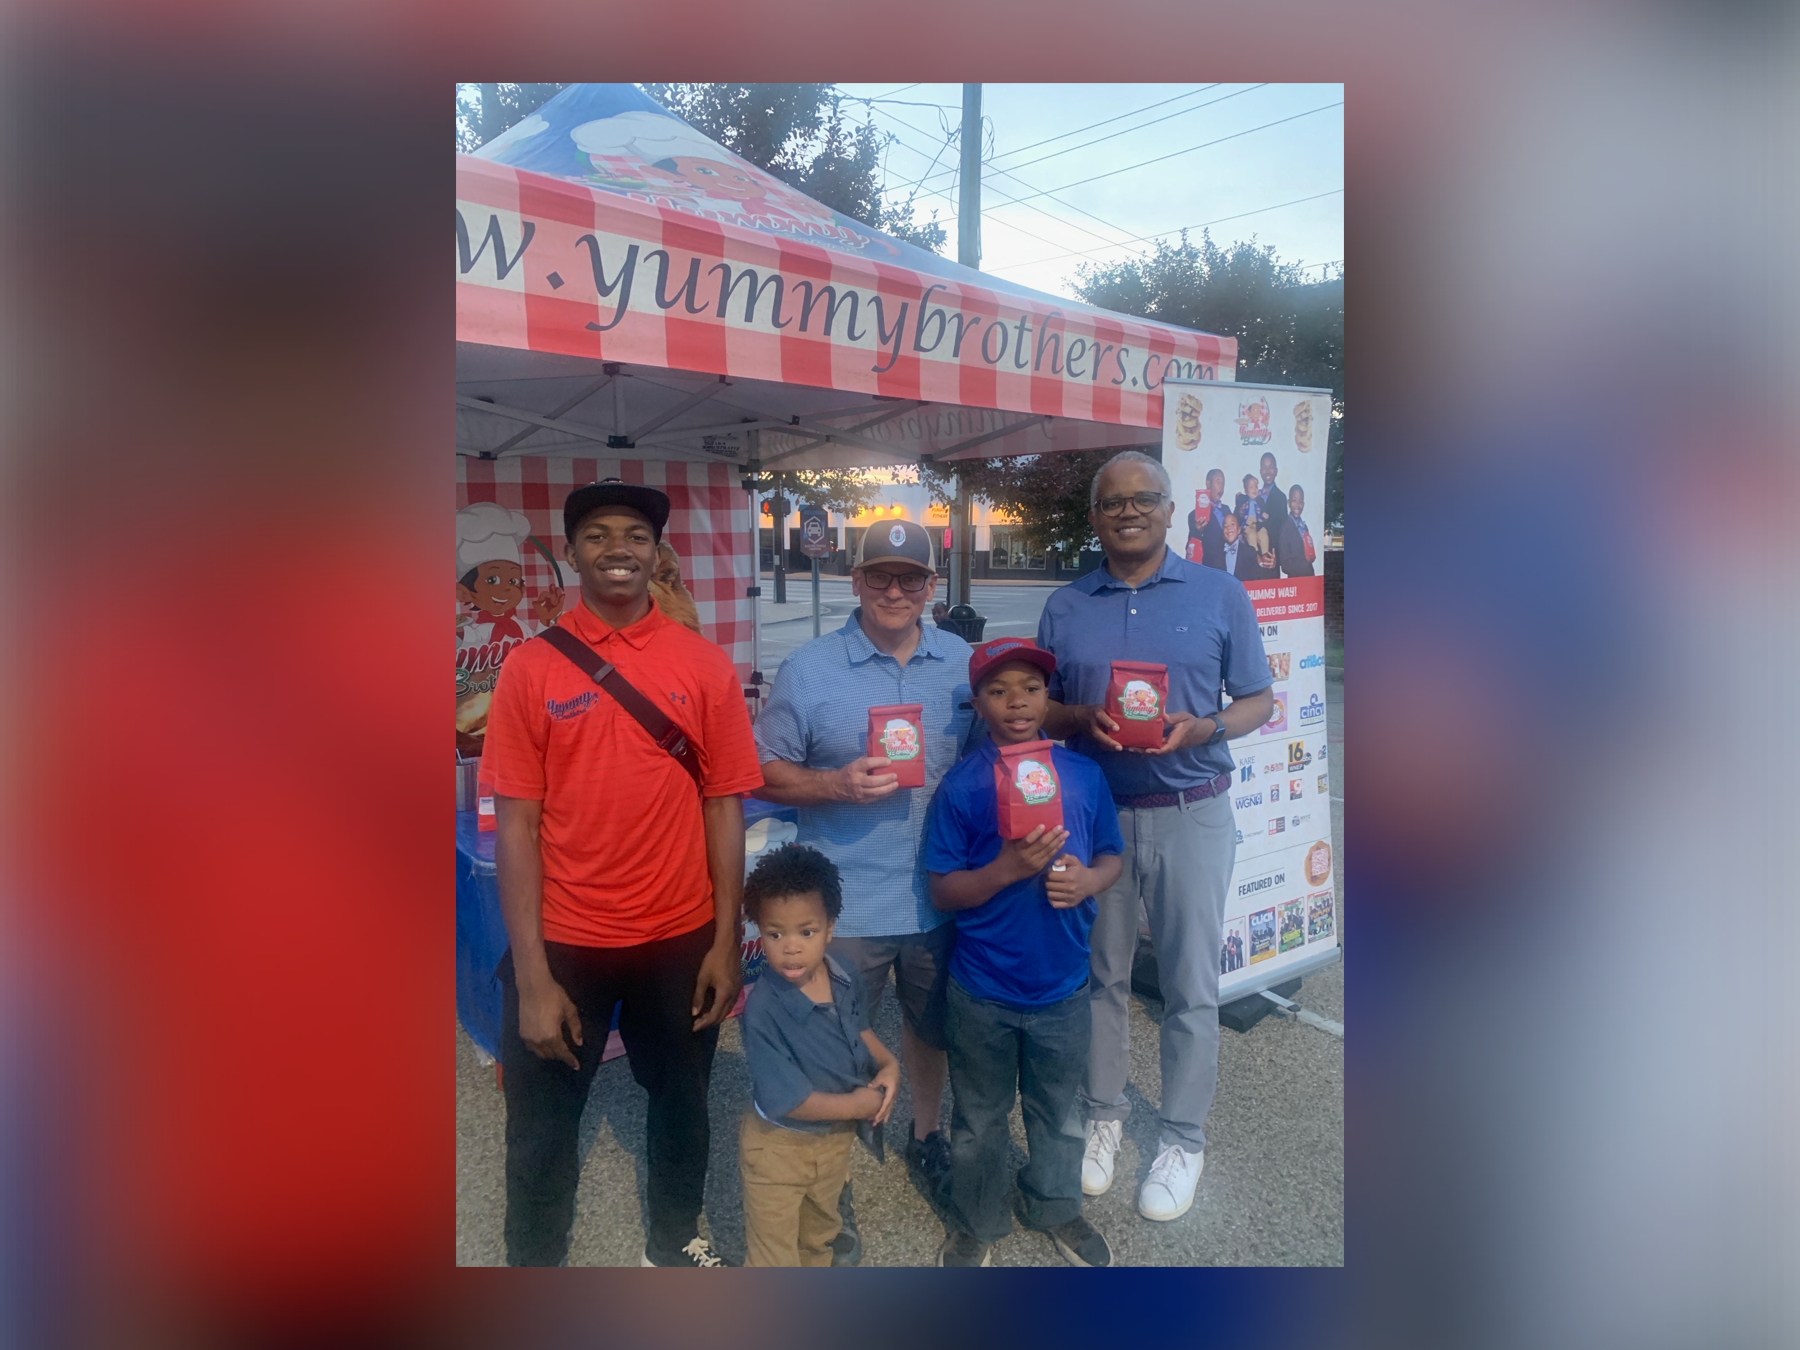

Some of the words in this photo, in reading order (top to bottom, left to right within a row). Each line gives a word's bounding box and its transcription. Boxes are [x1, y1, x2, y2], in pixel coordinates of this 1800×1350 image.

[1278, 586, 1297, 598] WAY!
[1256, 606, 1286, 617] DELIVERED
[1288, 604, 1304, 614] SINCE
[1306, 602, 1318, 612] 2017
[1267, 625, 1278, 636] ON
[456, 668, 500, 697] Brot
[547, 691, 594, 716] Yummy
[1288, 742, 1303, 762] 16
[1239, 756, 1256, 766] KARE
[1238, 877, 1272, 897] FEATURED
[1274, 873, 1285, 885] ON
